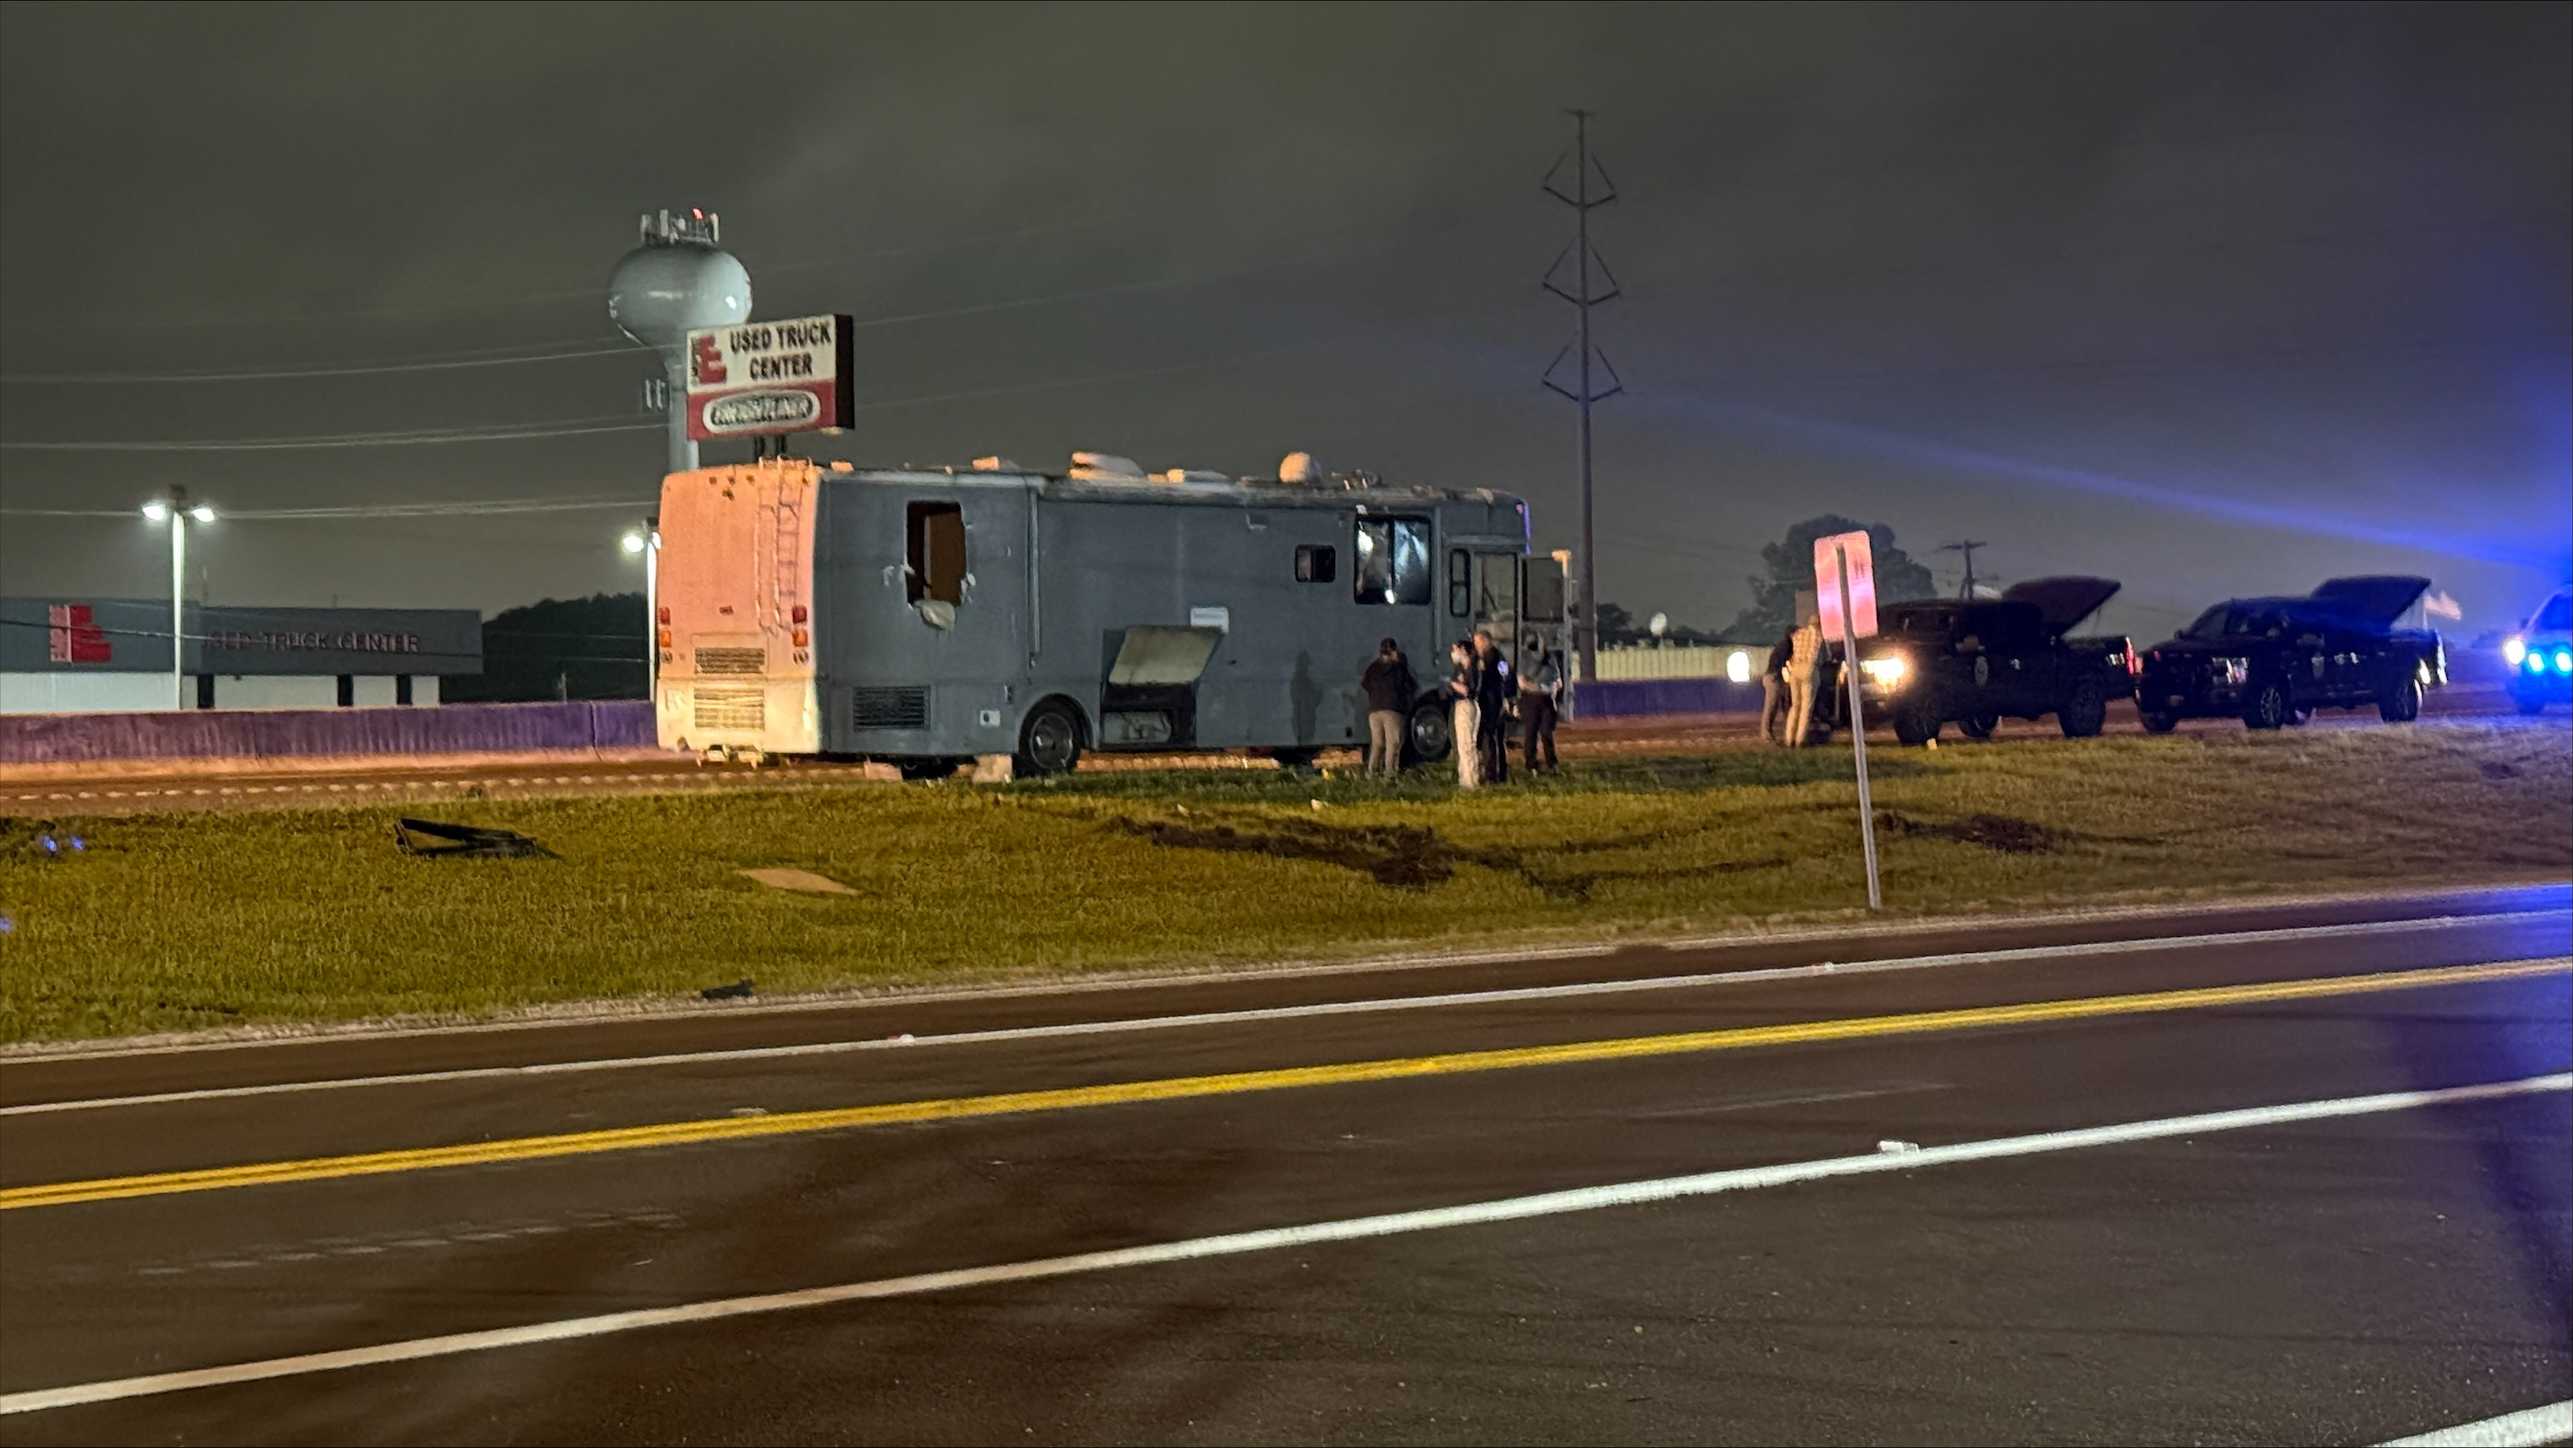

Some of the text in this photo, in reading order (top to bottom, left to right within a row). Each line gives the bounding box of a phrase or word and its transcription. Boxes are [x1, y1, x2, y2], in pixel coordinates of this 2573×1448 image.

[730, 320, 832, 353] USED TRUCK
[750, 352, 813, 380] CENTER
[338, 631, 420, 652] CENTER
